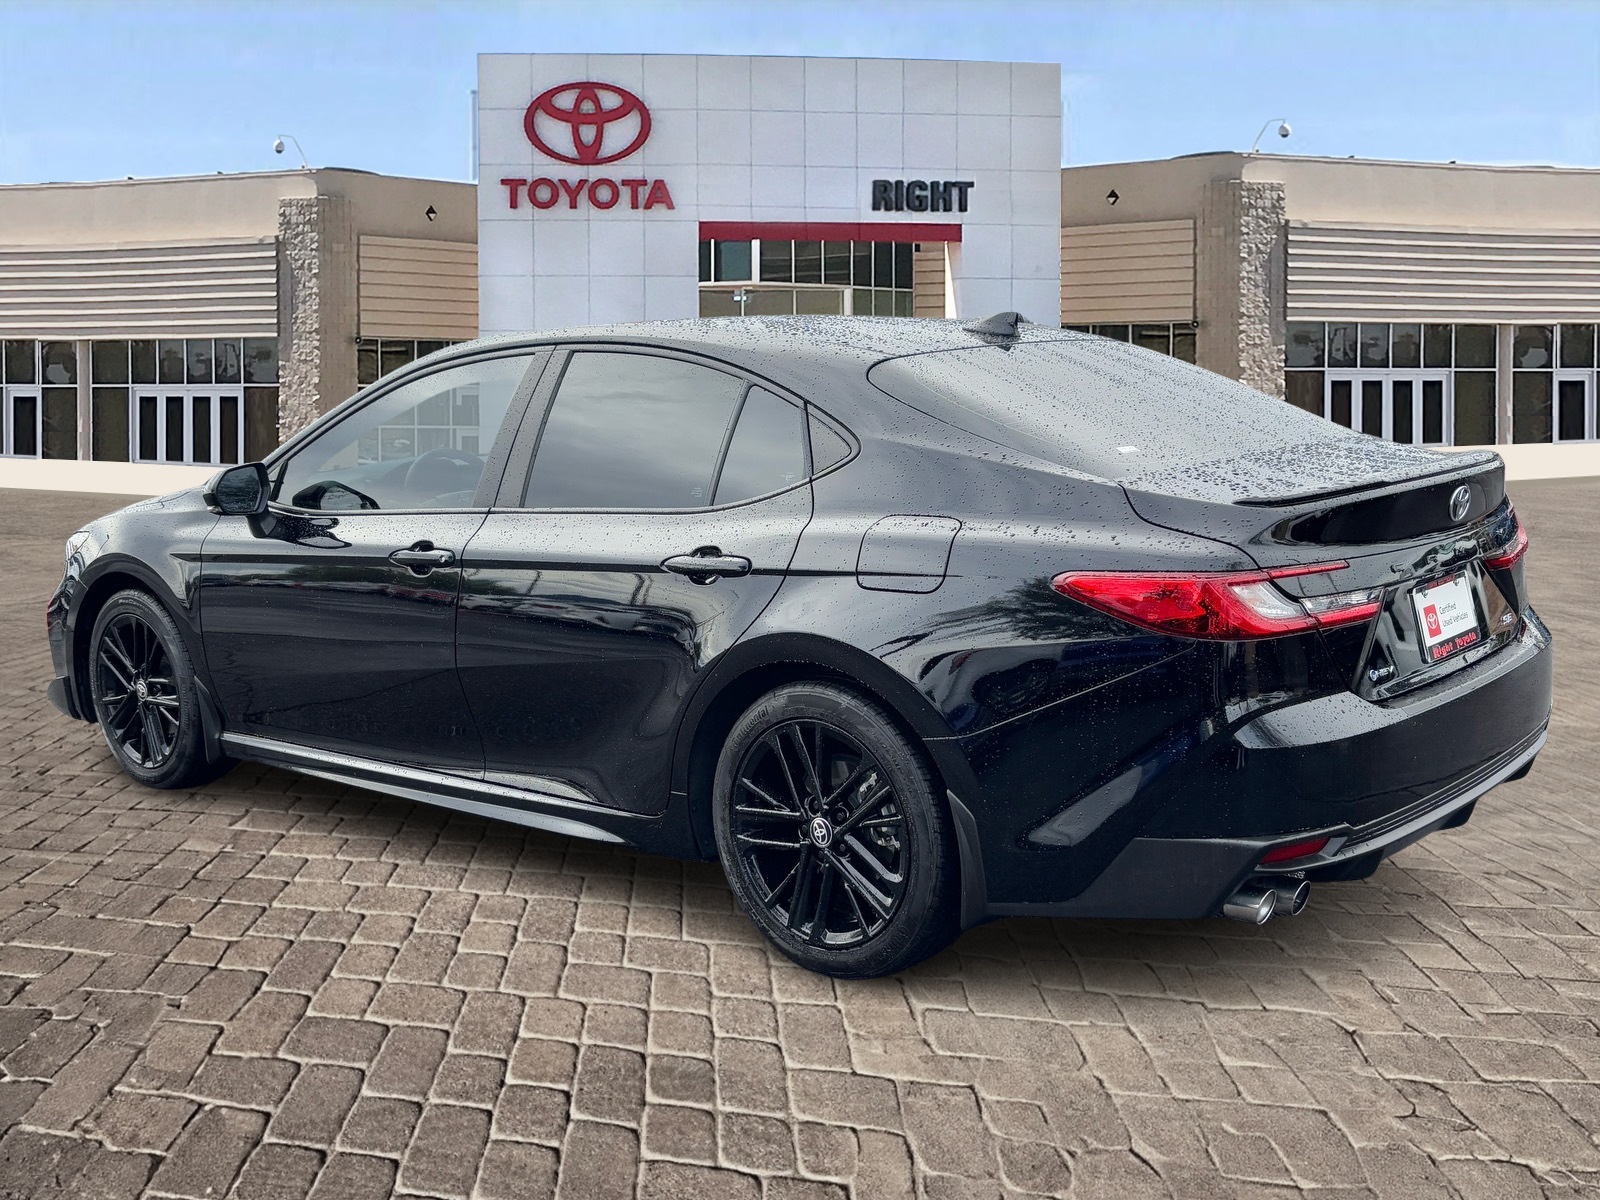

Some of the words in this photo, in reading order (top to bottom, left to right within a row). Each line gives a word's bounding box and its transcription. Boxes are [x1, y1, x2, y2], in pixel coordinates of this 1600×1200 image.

[500, 177, 676, 210] TOYOTA
[871, 179, 975, 212] RIGHT
[1438, 601, 1456, 614] Certified
[1502, 612, 1513, 624] SE
[1442, 615, 1453, 627] Used
[1453, 611, 1469, 623] Vehicles
[1432, 641, 1454, 659] Right
[1455, 631, 1477, 649] Toyota
